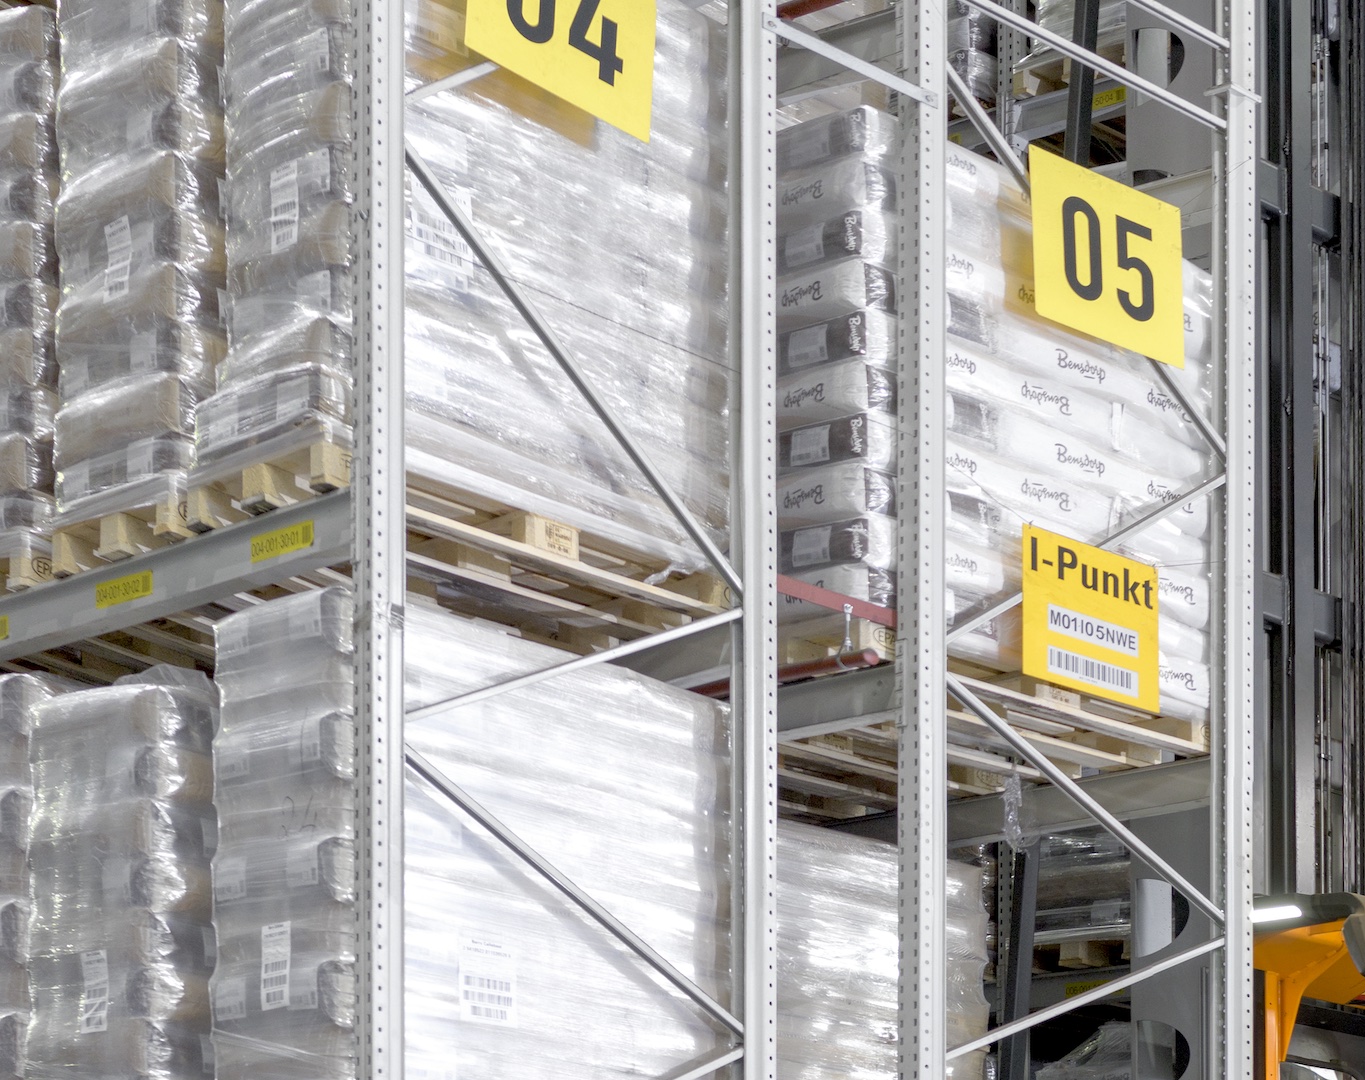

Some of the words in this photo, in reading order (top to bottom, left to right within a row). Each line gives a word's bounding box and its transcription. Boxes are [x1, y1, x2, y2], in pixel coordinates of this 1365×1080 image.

[1062, 196, 1154, 322] 05
[782, 281, 824, 307] Bensdorp
[1055, 348, 1106, 384] Bensdorp
[784, 383, 826, 408] Bensdorp
[1021, 381, 1073, 416] Bensdorp
[1055, 443, 1106, 478] Bensdorp
[784, 484, 826, 510] Bensdorp
[1021, 478, 1072, 512] Bensdorp
[1030, 535, 1153, 610] I-Punkt
